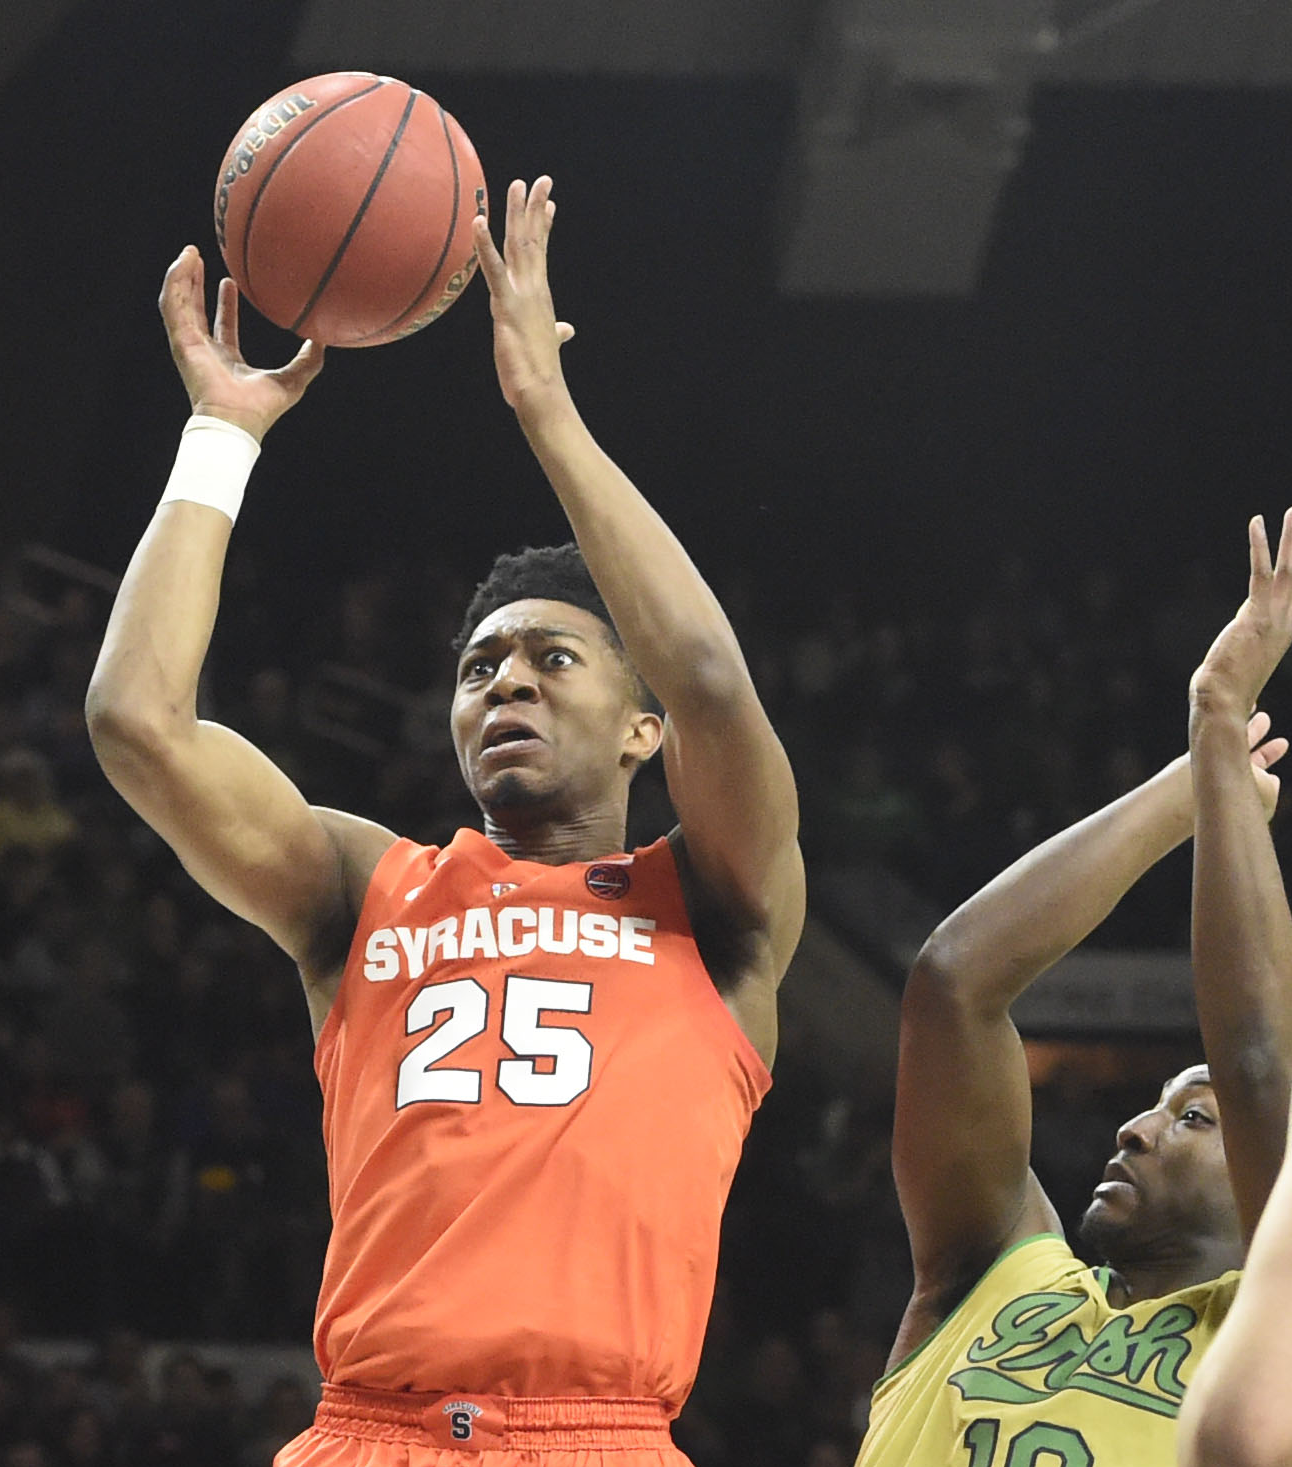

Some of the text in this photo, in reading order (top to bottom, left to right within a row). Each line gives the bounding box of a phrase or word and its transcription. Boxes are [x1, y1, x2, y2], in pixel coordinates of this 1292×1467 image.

[363, 906, 657, 982] SYRACUSE
[396, 974, 594, 1112] 25
[965, 1290, 1198, 1401] Irsh
[450, 1410, 473, 1441] S
